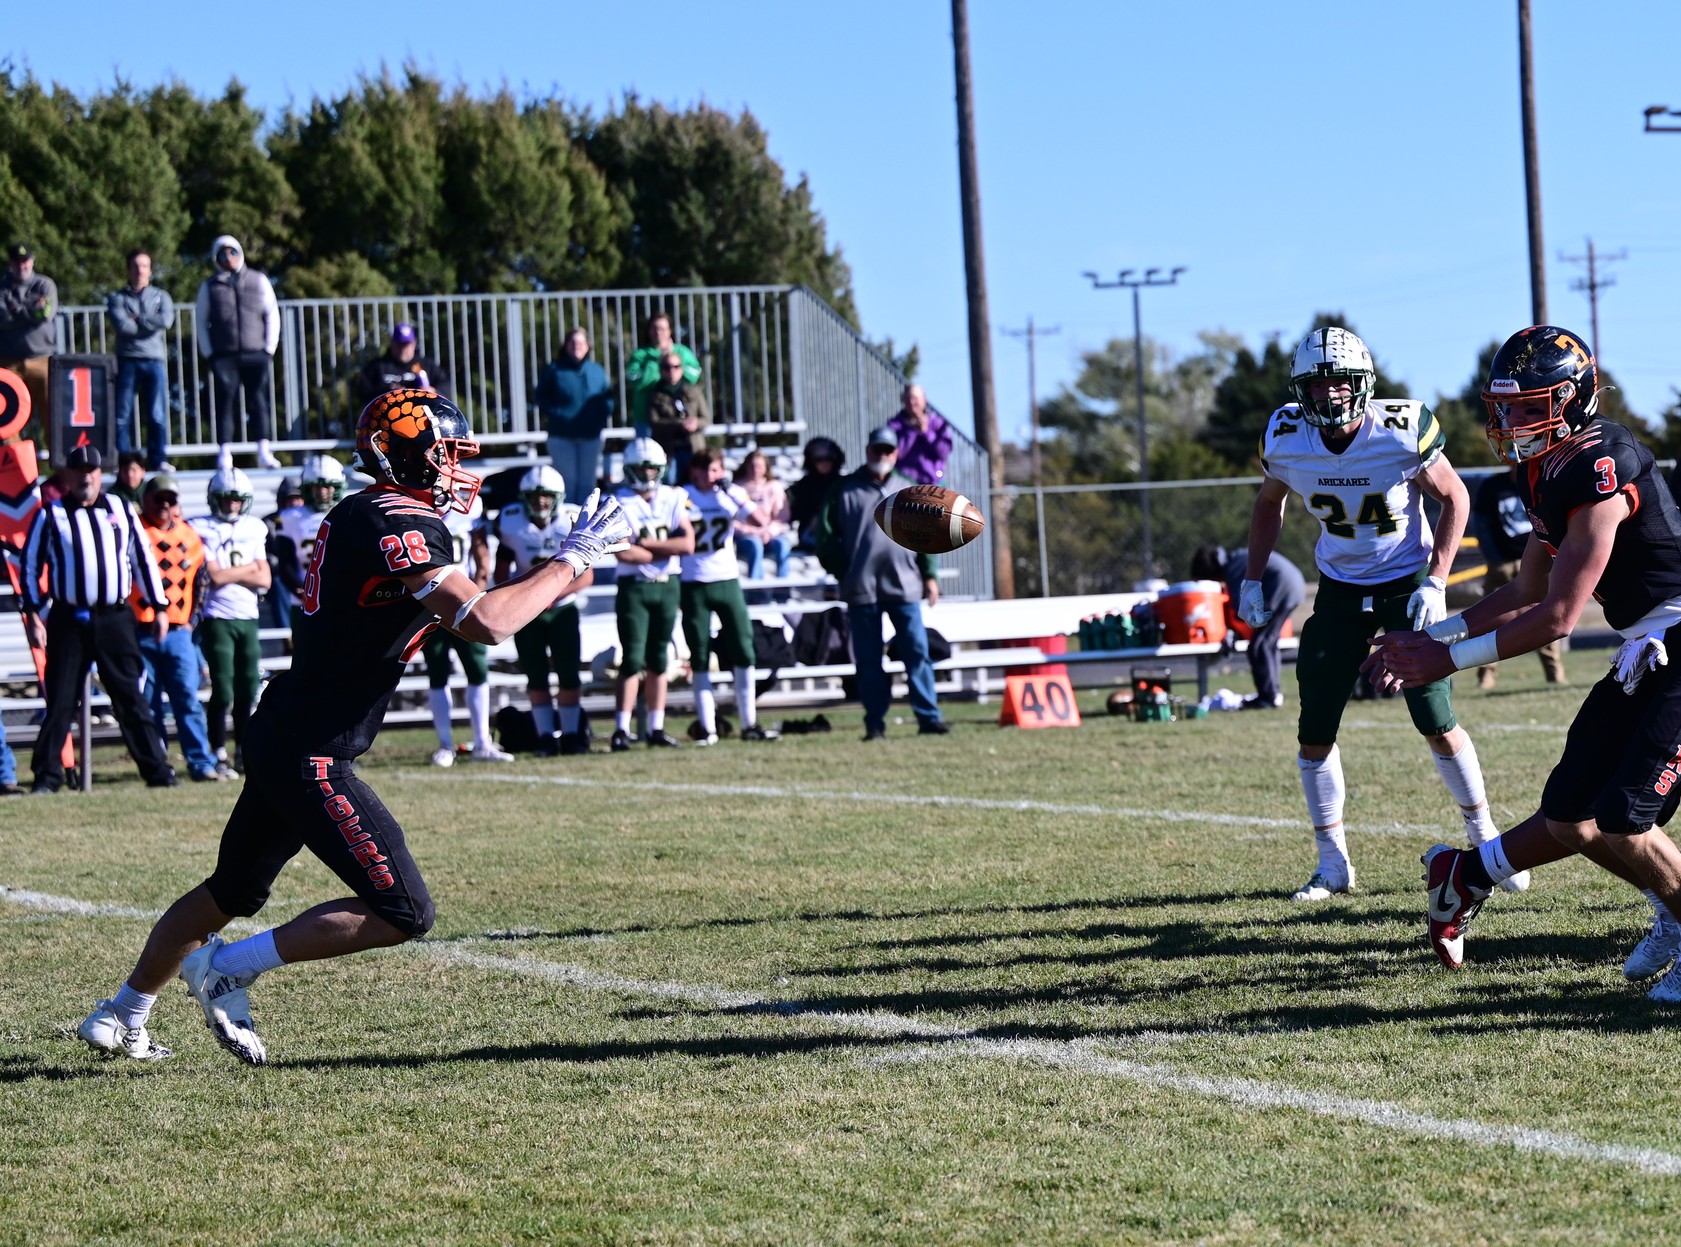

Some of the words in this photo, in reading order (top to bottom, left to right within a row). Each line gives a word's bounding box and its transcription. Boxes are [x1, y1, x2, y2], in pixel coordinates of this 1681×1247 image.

[68, 367, 95, 427] 1
[1273, 409, 1302, 439] 24
[1384, 404, 1411, 431] 24
[1318, 477, 1371, 487] ARICKAREE
[1594, 456, 1618, 494] 3
[1309, 493, 1399, 540] 24
[379, 530, 431, 571] 28
[1022, 682, 1071, 720] 40
[310, 756, 395, 890] TIGERS
